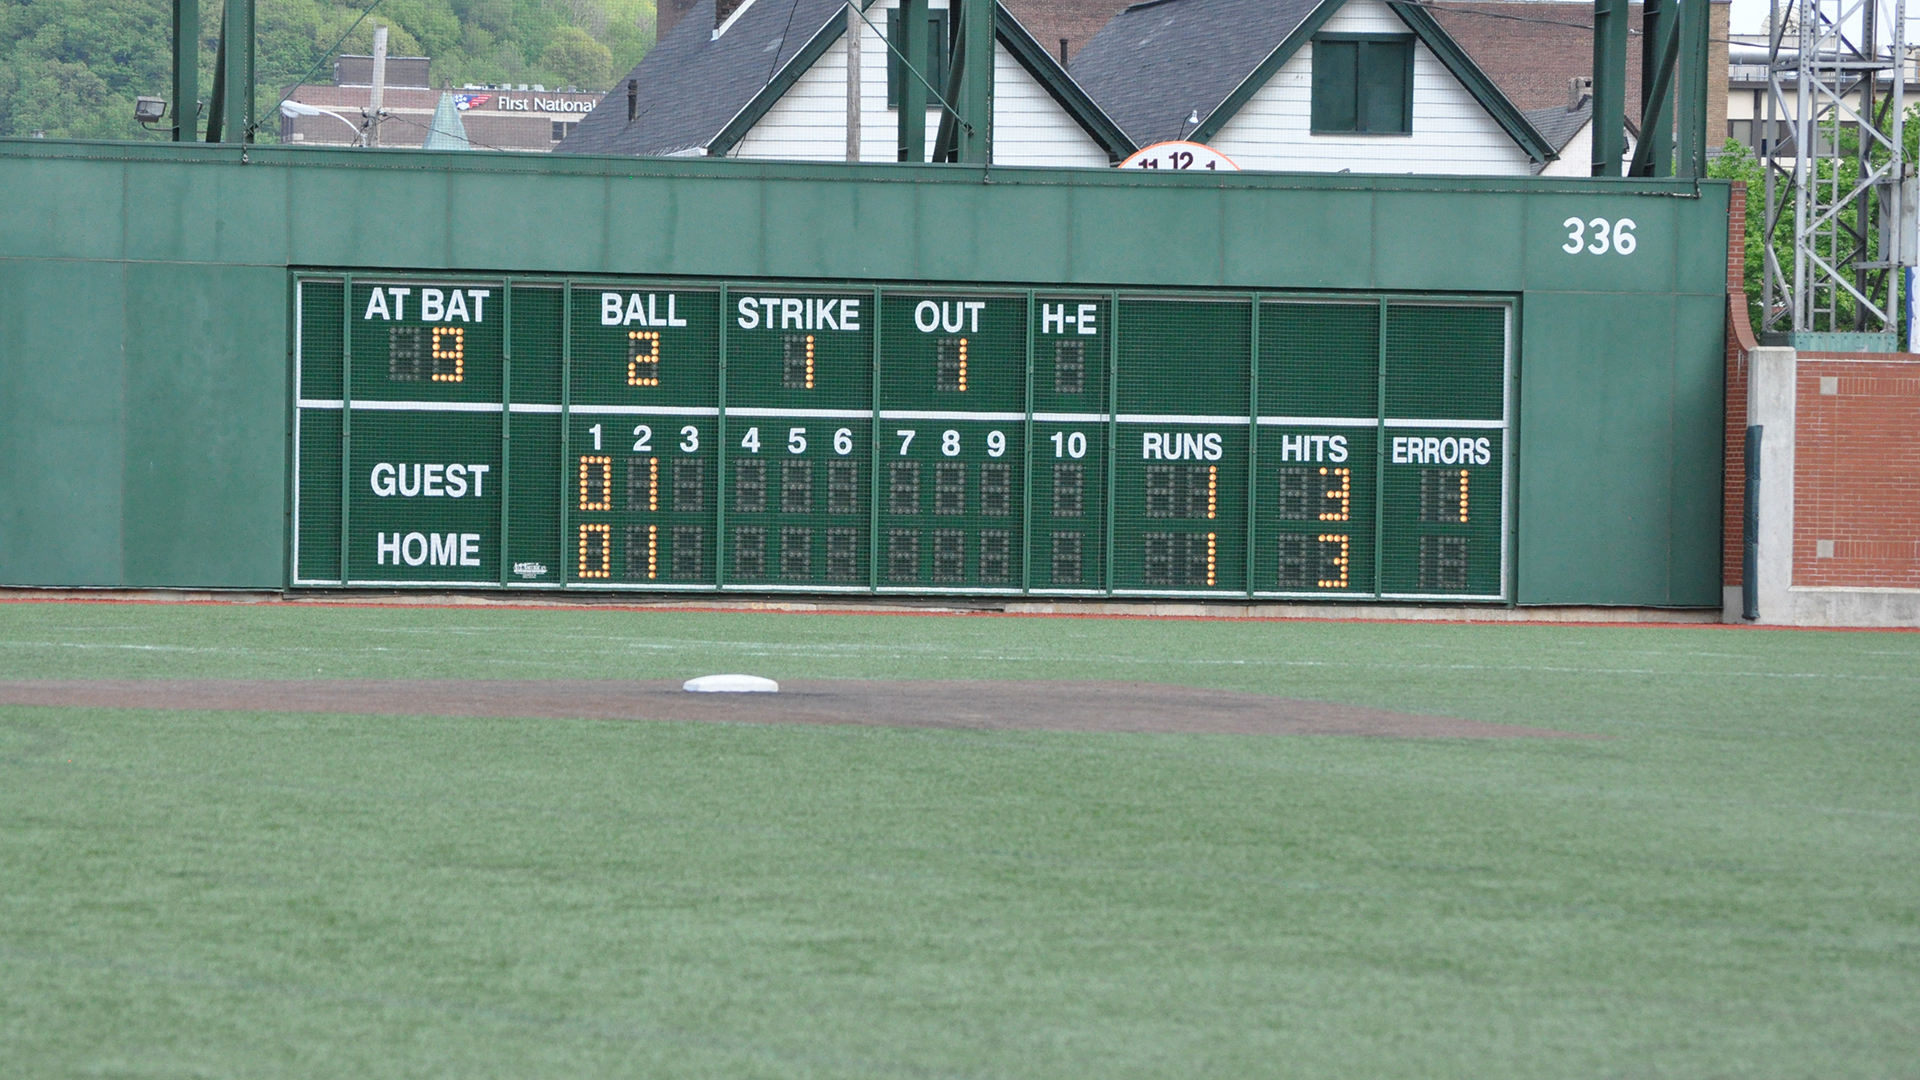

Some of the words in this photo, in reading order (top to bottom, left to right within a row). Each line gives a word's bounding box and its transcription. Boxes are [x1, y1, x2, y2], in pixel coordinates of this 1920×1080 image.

[498, 96, 529, 111] First
[534, 97, 596, 112] National
[1169, 151, 1194, 169] 12
[1562, 217, 1637, 256] 336
[365, 287, 411, 321] AT
[421, 289, 490, 322] BAT
[601, 292, 687, 327] BALL
[737, 296, 860, 331] STRIKE
[914, 300, 986, 333] OUT
[1042, 303, 1097, 335] H-E
[432, 327, 464, 382] 9
[628, 332, 660, 387] 2
[805, 335, 815, 389] 1
[958, 339, 968, 392] 1
[589, 424, 601, 451] 1
[633, 424, 652, 452] 2
[680, 425, 699, 453] 3
[741, 428, 761, 453] 4
[788, 428, 807, 454] 5
[834, 428, 853, 455] 6
[897, 430, 916, 455] 7
[942, 430, 961, 457] 8
[988, 430, 1006, 457] 9
[1051, 431, 1087, 459] 10
[1142, 433, 1223, 461] RUNS
[1281, 434, 1349, 463] HITS
[1392, 437, 1491, 465] ERRORS
[371, 463, 490, 498] GUEST
[580, 456, 612, 511] 0
[649, 457, 658, 511] 1
[1207, 465, 1217, 519] 1
[1319, 467, 1350, 521] 3
[1459, 469, 1469, 523] 1
[377, 532, 481, 566] HOME
[579, 523, 611, 578] 0
[648, 525, 657, 579] 1
[1206, 532, 1216, 586] 1
[1318, 534, 1349, 588] 3
